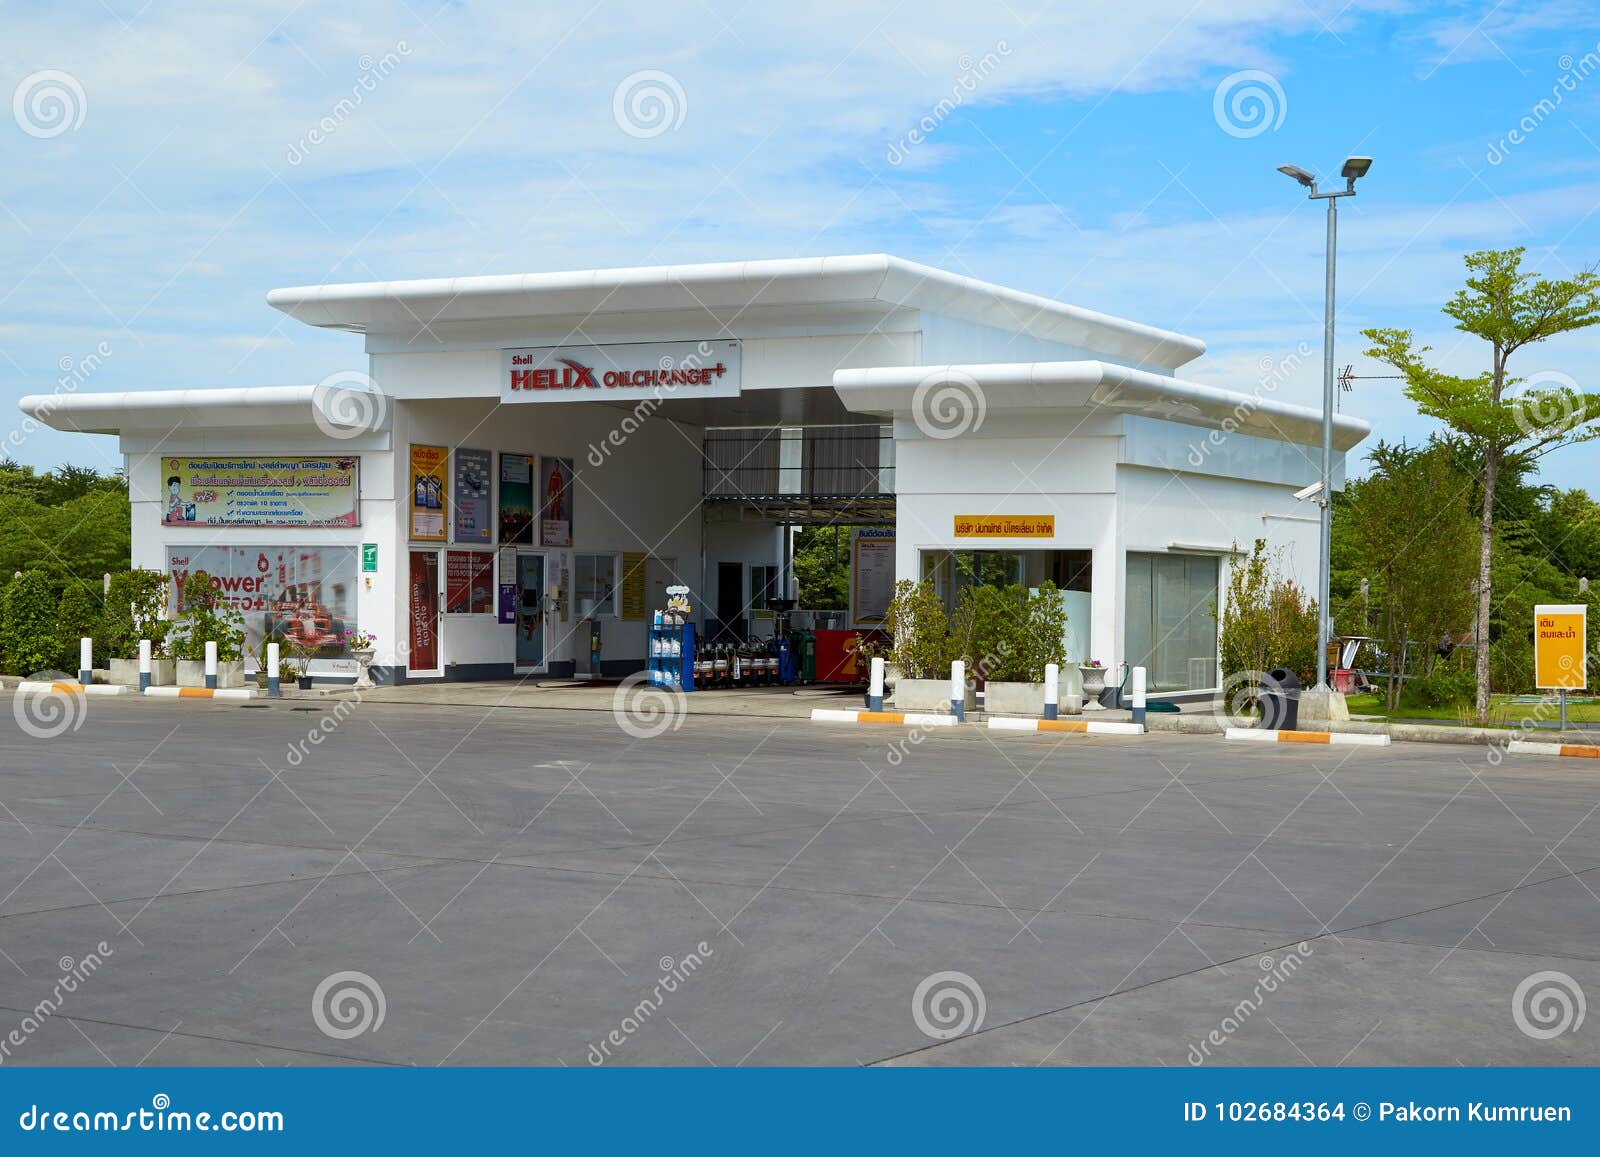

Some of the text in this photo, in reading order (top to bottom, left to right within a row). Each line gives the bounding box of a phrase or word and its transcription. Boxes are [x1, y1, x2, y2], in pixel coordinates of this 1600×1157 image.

[511, 354, 533, 365] Shell
[510, 367, 596, 390] HELIX
[171, 556, 189, 565] Shell
[1540, 618, 1554, 627] เติม
[1540, 627, 1576, 638] ลมและน้ำ
